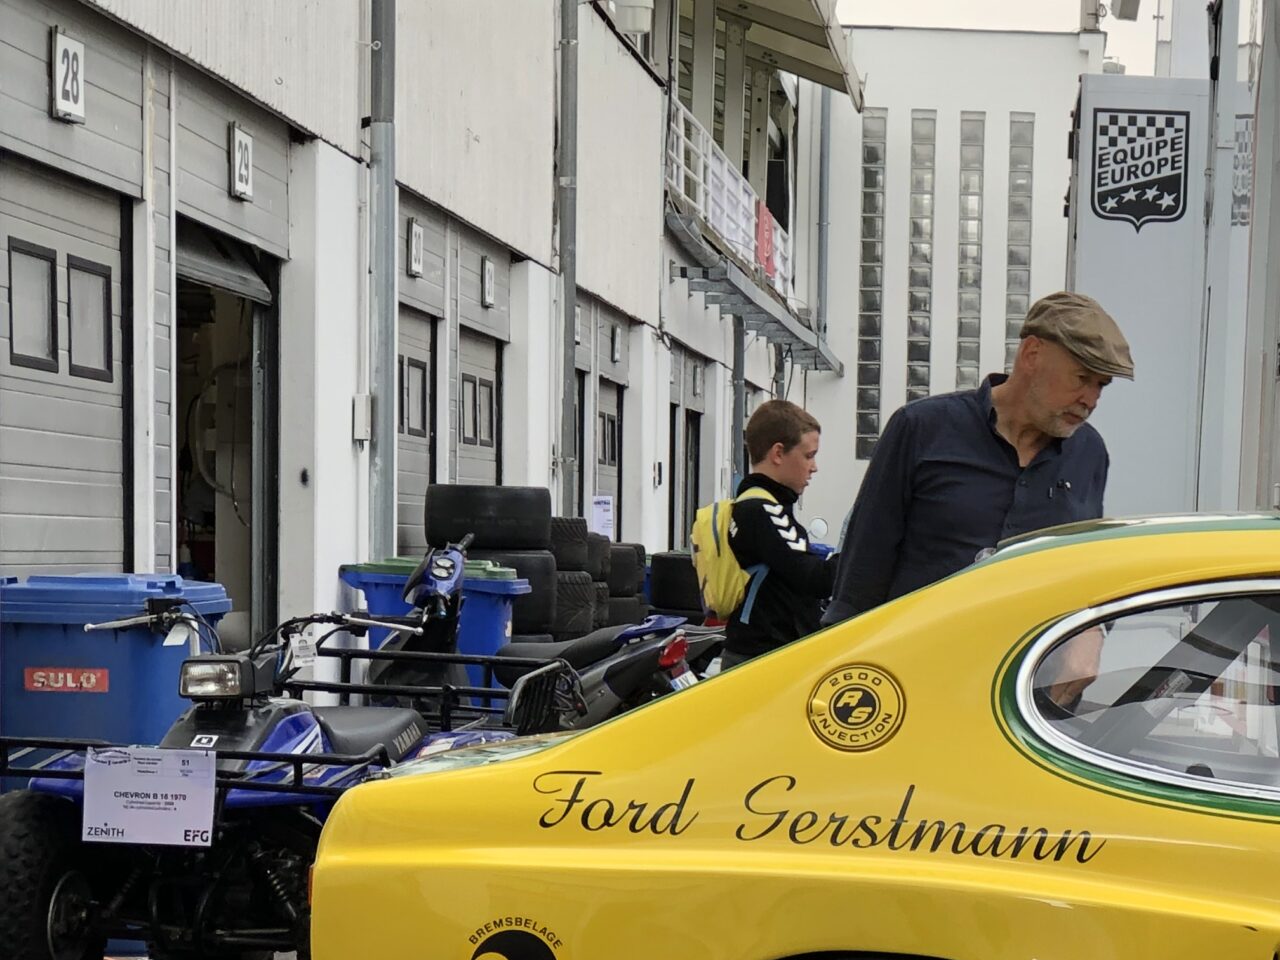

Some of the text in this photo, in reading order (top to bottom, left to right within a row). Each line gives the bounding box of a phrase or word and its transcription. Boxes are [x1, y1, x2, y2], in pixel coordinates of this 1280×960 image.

[61, 48, 80, 105] 28
[237, 139, 250, 186] 29
[1097, 135, 1184, 169] EQUIPE
[1097, 153, 1183, 188] EUROPE
[32, 671, 97, 689] SULO
[829, 672, 882, 687] 2600
[391, 721, 422, 755] YAMAHA
[816, 712, 893, 743] INJECTION
[113, 790, 151, 800] CHEVRON
[87, 826, 125, 838] ZENITH
[533, 770, 1107, 864] Ford Gerstmann
[184, 829, 209, 843] EFG
[468, 916, 563, 950] BREMSBELAGE
